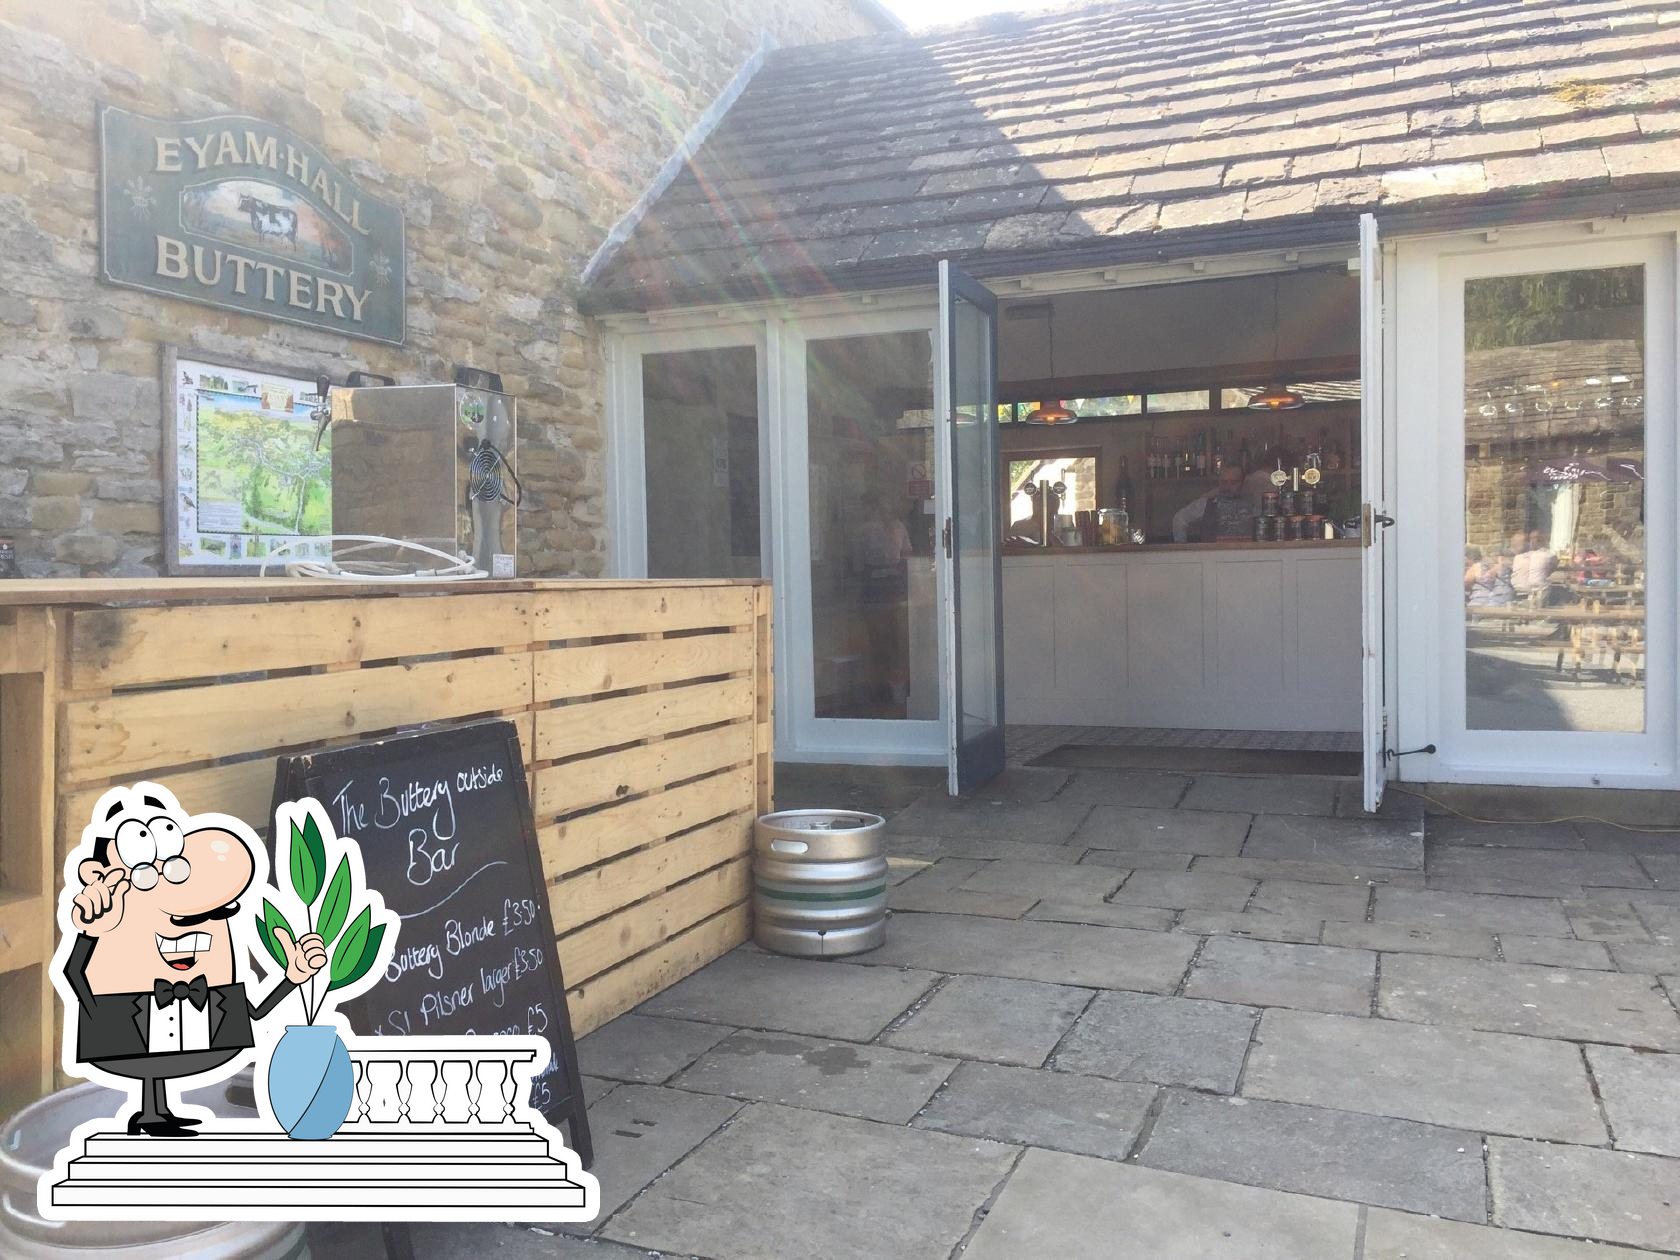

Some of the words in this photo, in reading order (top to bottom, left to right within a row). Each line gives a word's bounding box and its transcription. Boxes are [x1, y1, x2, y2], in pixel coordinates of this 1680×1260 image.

[155, 235, 373, 322] BUTTERY
[332, 779, 368, 836] The
[374, 776, 456, 840] Buttery
[456, 763, 504, 793] outside
[406, 828, 460, 886] Bar
[444, 916, 496, 956] Blonde
[420, 983, 474, 1026] Pilsner
[527, 1002, 548, 1035] £5
